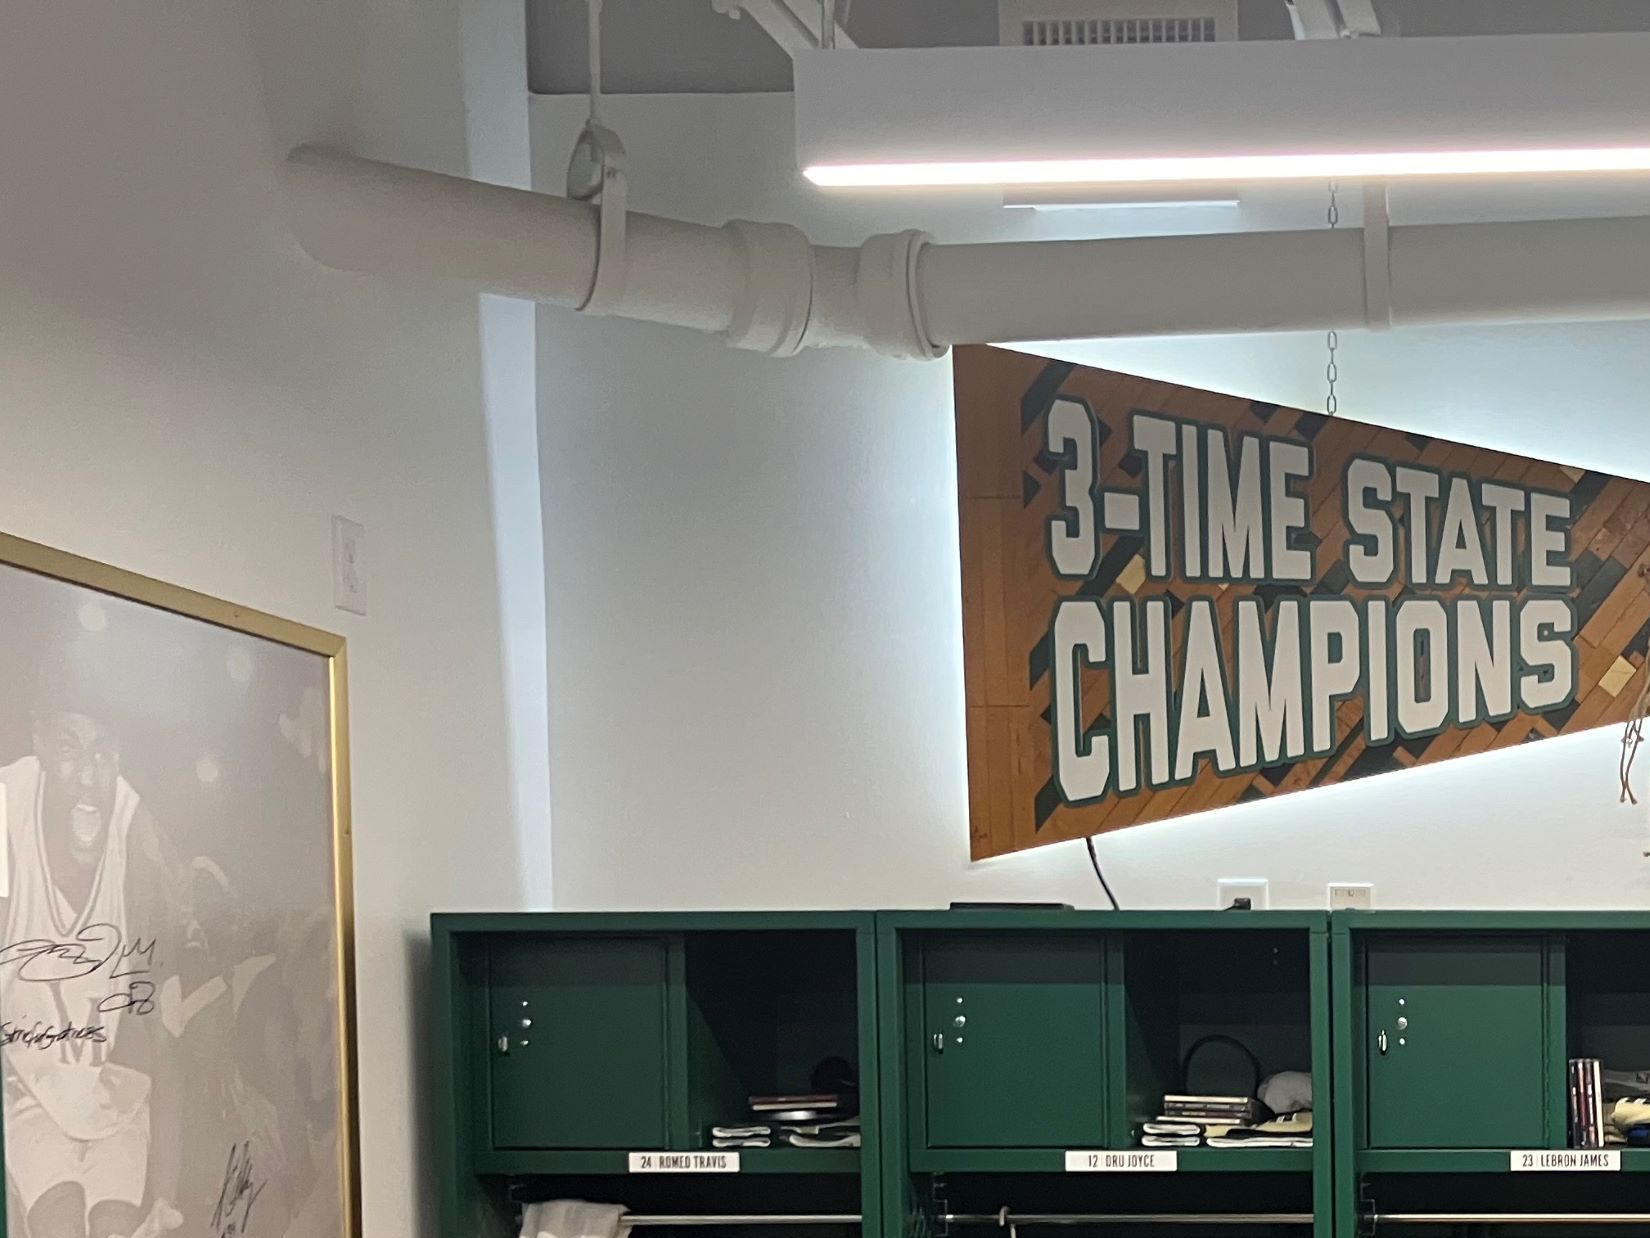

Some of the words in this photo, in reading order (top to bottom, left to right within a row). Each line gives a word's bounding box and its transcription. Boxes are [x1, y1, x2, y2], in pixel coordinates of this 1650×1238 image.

[1045, 398, 1312, 580] 3-TIME
[1346, 457, 1572, 587] STATE
[1053, 599, 1575, 802] CHAMPIONS
[640, 1155, 652, 1169] 24
[659, 1155, 691, 1169] ROMEO
[693, 1155, 727, 1169] TRAVIS
[1088, 1154, 1099, 1168] 12
[1105, 1154, 1125, 1168] DRU
[1127, 1154, 1155, 1168] JOYCE
[1522, 1154, 1534, 1168] 23
[1540, 1154, 1577, 1168] LEBRON
[1579, 1154, 1609, 1168] JAMES
